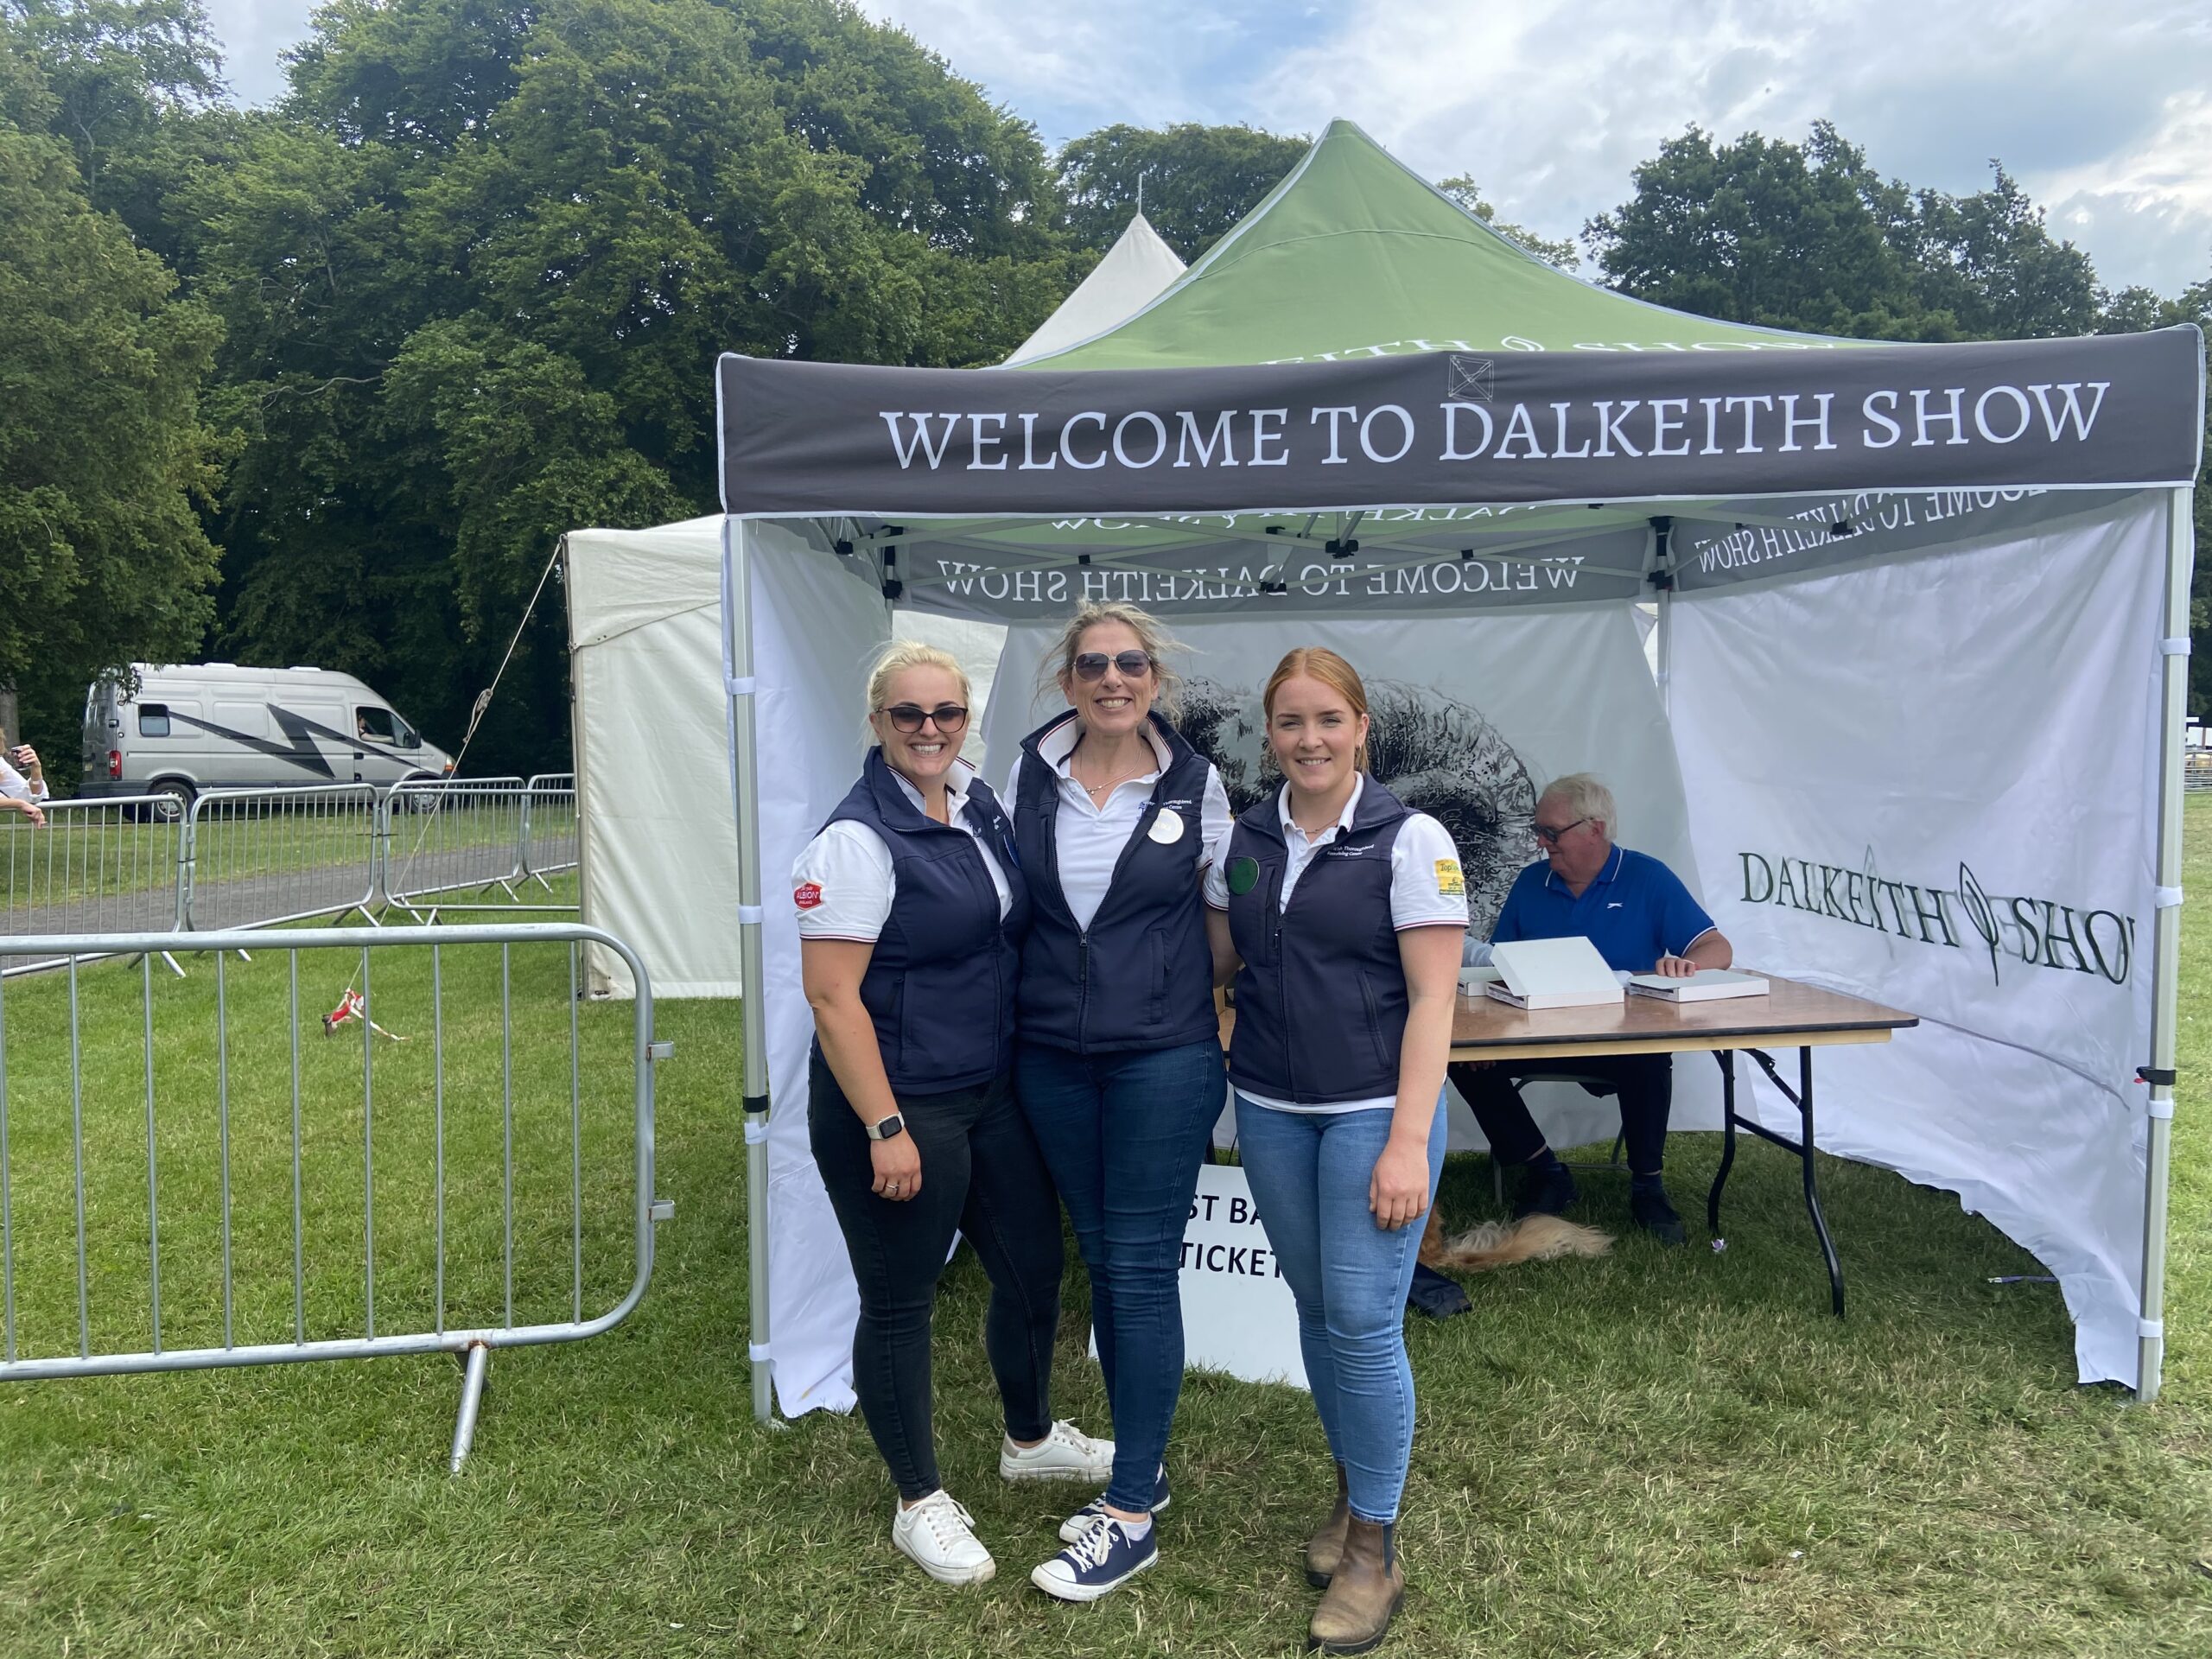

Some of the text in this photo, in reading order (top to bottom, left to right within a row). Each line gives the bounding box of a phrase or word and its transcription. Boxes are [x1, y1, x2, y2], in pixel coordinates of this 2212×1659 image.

[880, 381, 2111, 471] WELCOME TO DALKEITH SHOW
[796, 891, 819, 899] ALBION
[1738, 851, 1960, 948] DALKEITH
[2012, 897, 2136, 986] SHO
